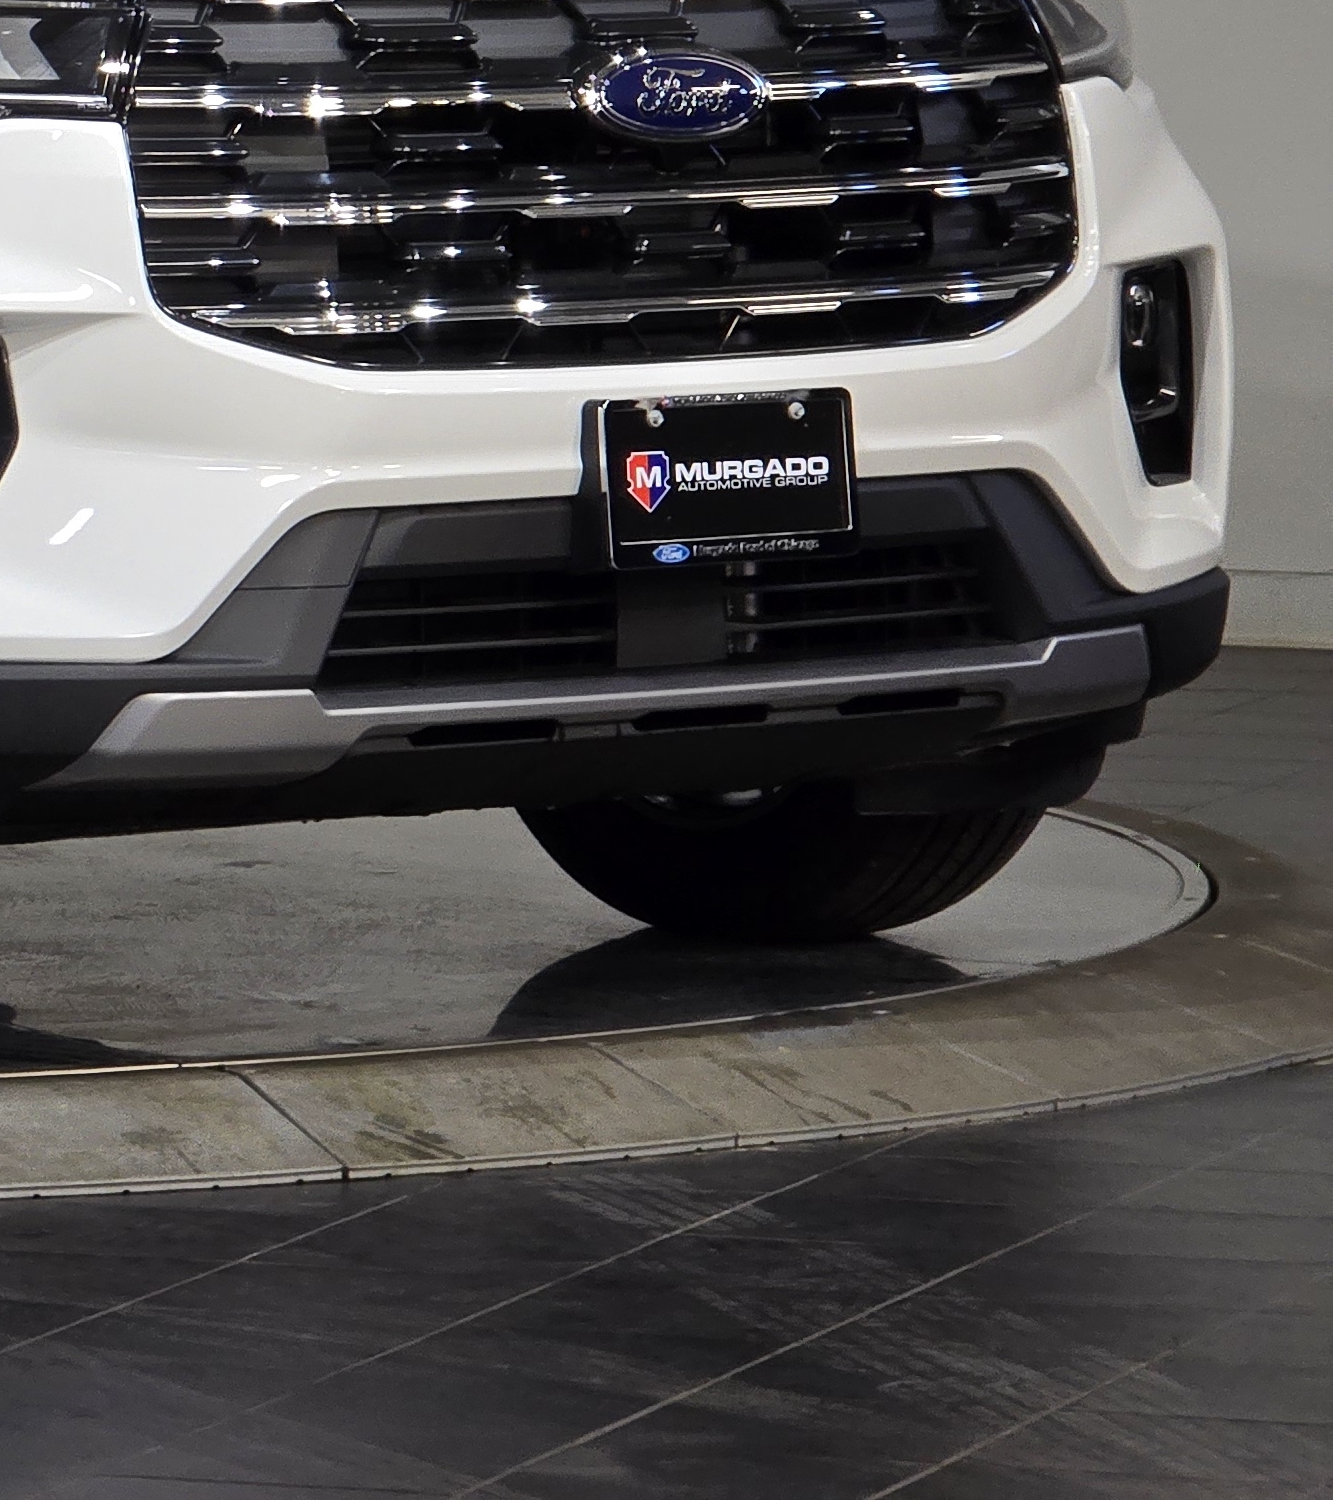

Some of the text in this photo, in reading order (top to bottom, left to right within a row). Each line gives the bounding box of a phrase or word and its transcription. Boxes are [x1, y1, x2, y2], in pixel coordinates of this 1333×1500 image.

[636, 66, 732, 117] Ford
[636, 466, 662, 489] M
[675, 456, 829, 483] MURGADO
[678, 474, 829, 492] AUTOMOTIVE GROUP
